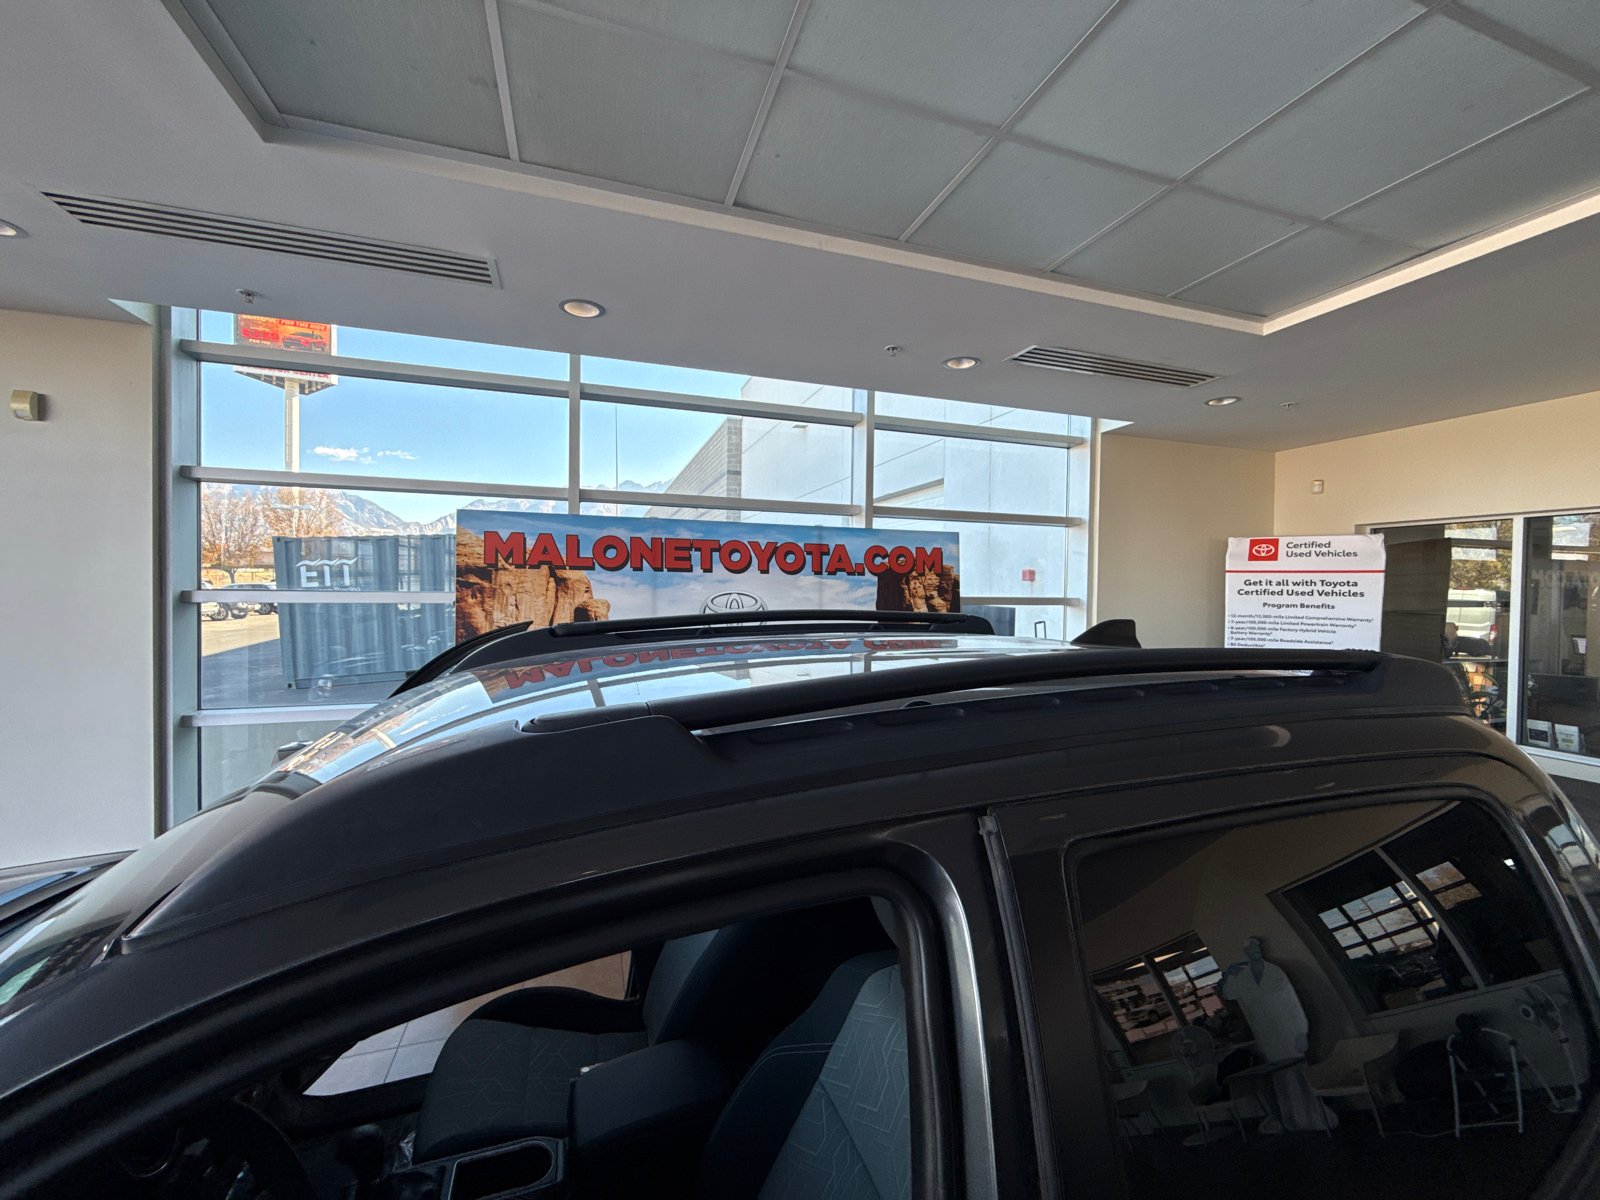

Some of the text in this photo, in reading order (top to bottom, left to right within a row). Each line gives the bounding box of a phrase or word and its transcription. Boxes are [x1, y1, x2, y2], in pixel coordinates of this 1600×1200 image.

[1286, 541, 1331, 549] Certified
[483, 531, 943, 576] MALONETOYOTA.COM
[1291, 579, 1317, 587] with
[1319, 580, 1358, 588] Toyota
[1286, 589, 1314, 597] Used
[1316, 589, 1365, 598] Vehicles
